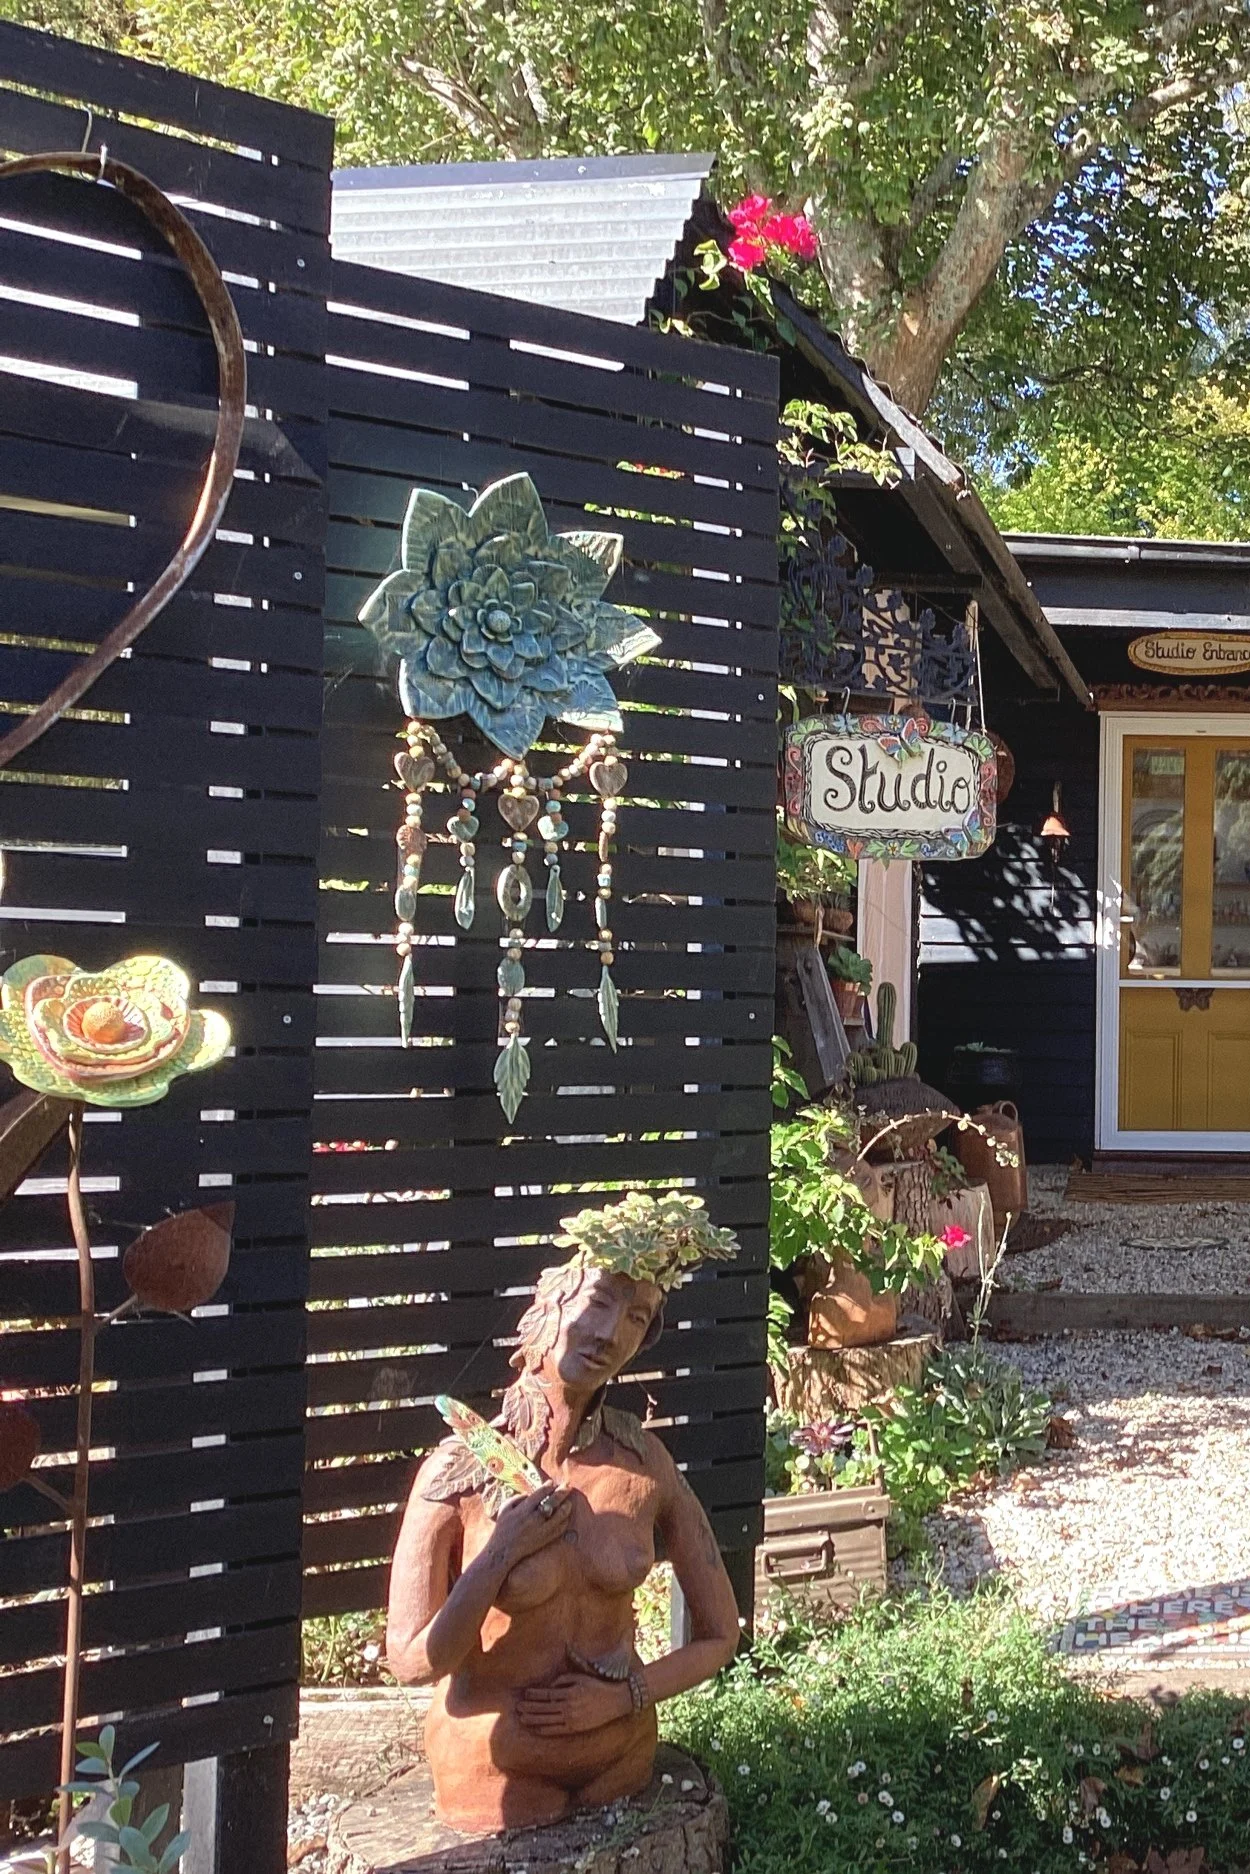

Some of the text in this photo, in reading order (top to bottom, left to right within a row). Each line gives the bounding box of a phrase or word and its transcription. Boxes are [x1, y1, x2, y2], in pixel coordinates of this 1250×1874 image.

[1144, 641, 1196, 660] Studio
[824, 744, 972, 814] Studio
[1085, 1616, 1159, 1631] THE
